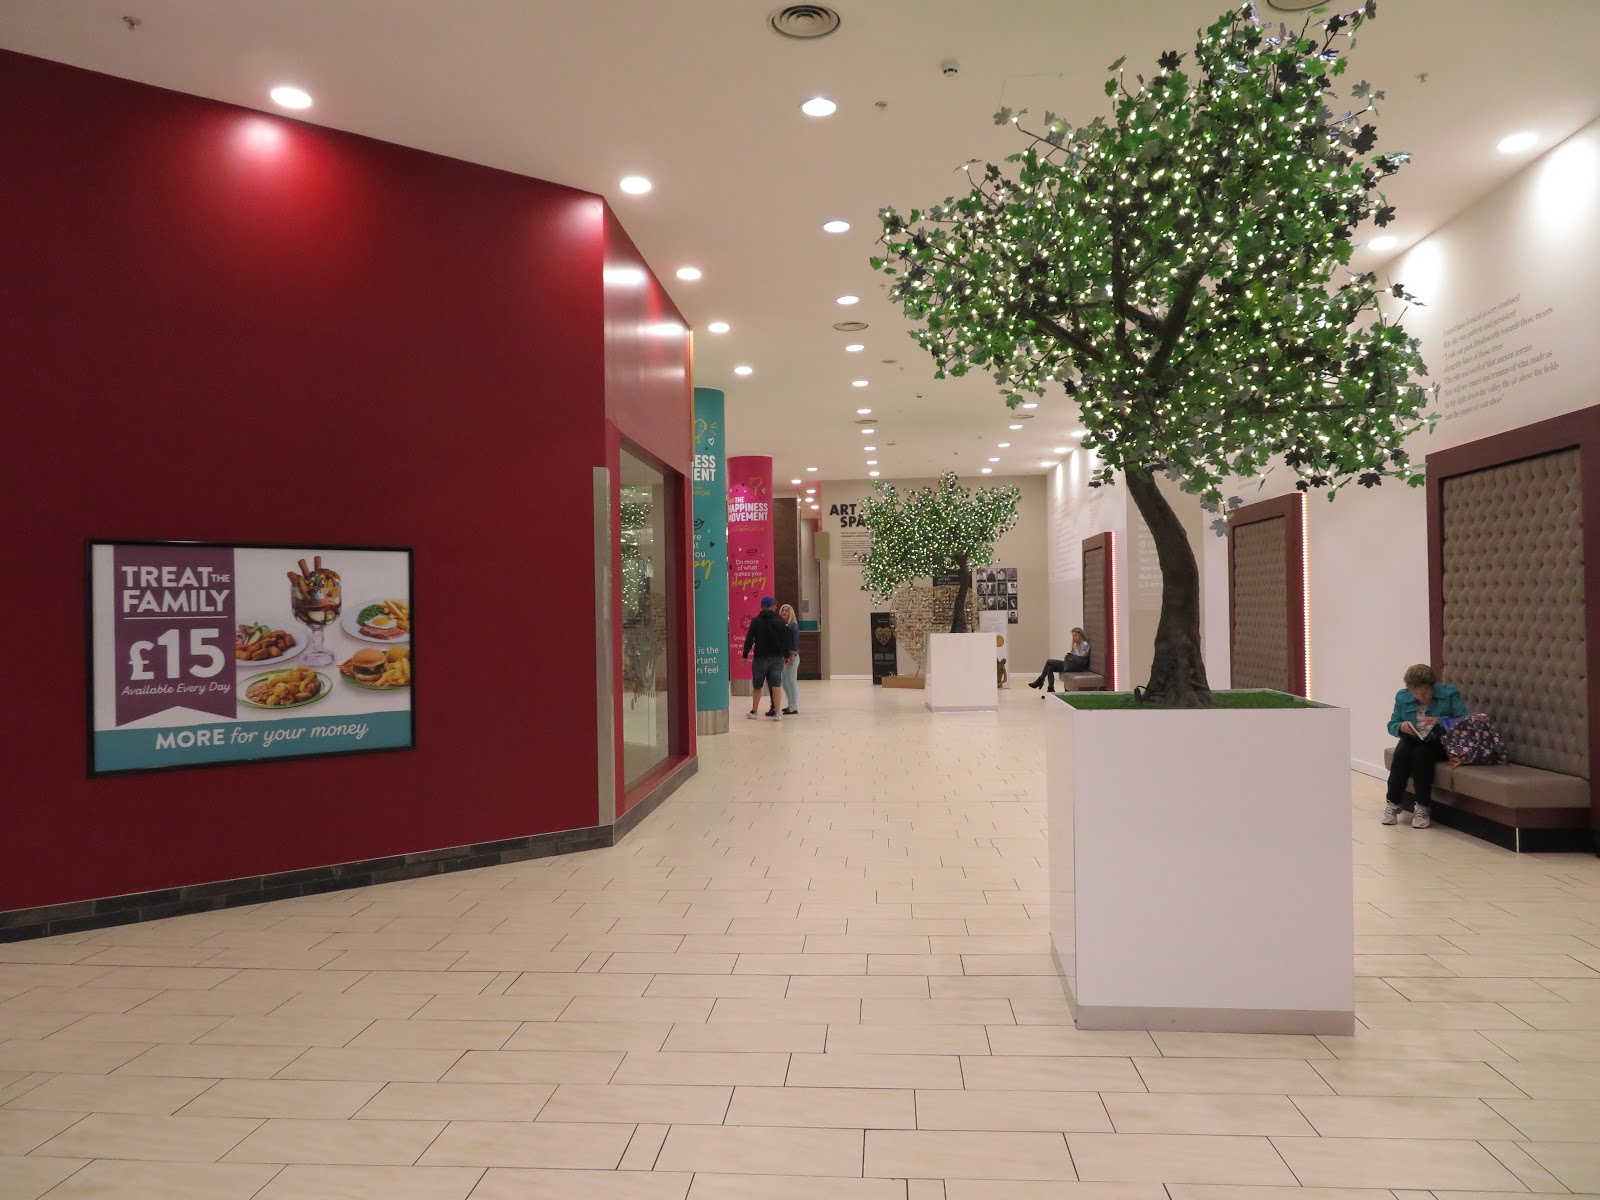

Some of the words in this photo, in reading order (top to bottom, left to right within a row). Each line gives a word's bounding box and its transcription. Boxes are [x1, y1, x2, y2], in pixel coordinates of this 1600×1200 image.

[692, 455, 716, 468] ESS
[692, 468, 716, 481] ENT
[728, 502, 768, 514] HAPPINESS
[829, 504, 857, 516] ART
[728, 512, 768, 522] MOVEMENT
[840, 516, 866, 528] SPA
[121, 566, 214, 588] TREAT
[210, 573, 231, 584] THE
[731, 575, 767, 591] Happy
[122, 589, 231, 613] FAMILY
[128, 628, 226, 681] £15
[706, 646, 719, 654] the
[704, 665, 719, 674] feel
[121, 684, 174, 696] Available
[176, 682, 206, 696] Every
[209, 681, 231, 695] Day
[155, 728, 226, 750] MORE
[229, 727, 257, 745] for
[263, 727, 306, 747] your
[310, 721, 368, 738] money
